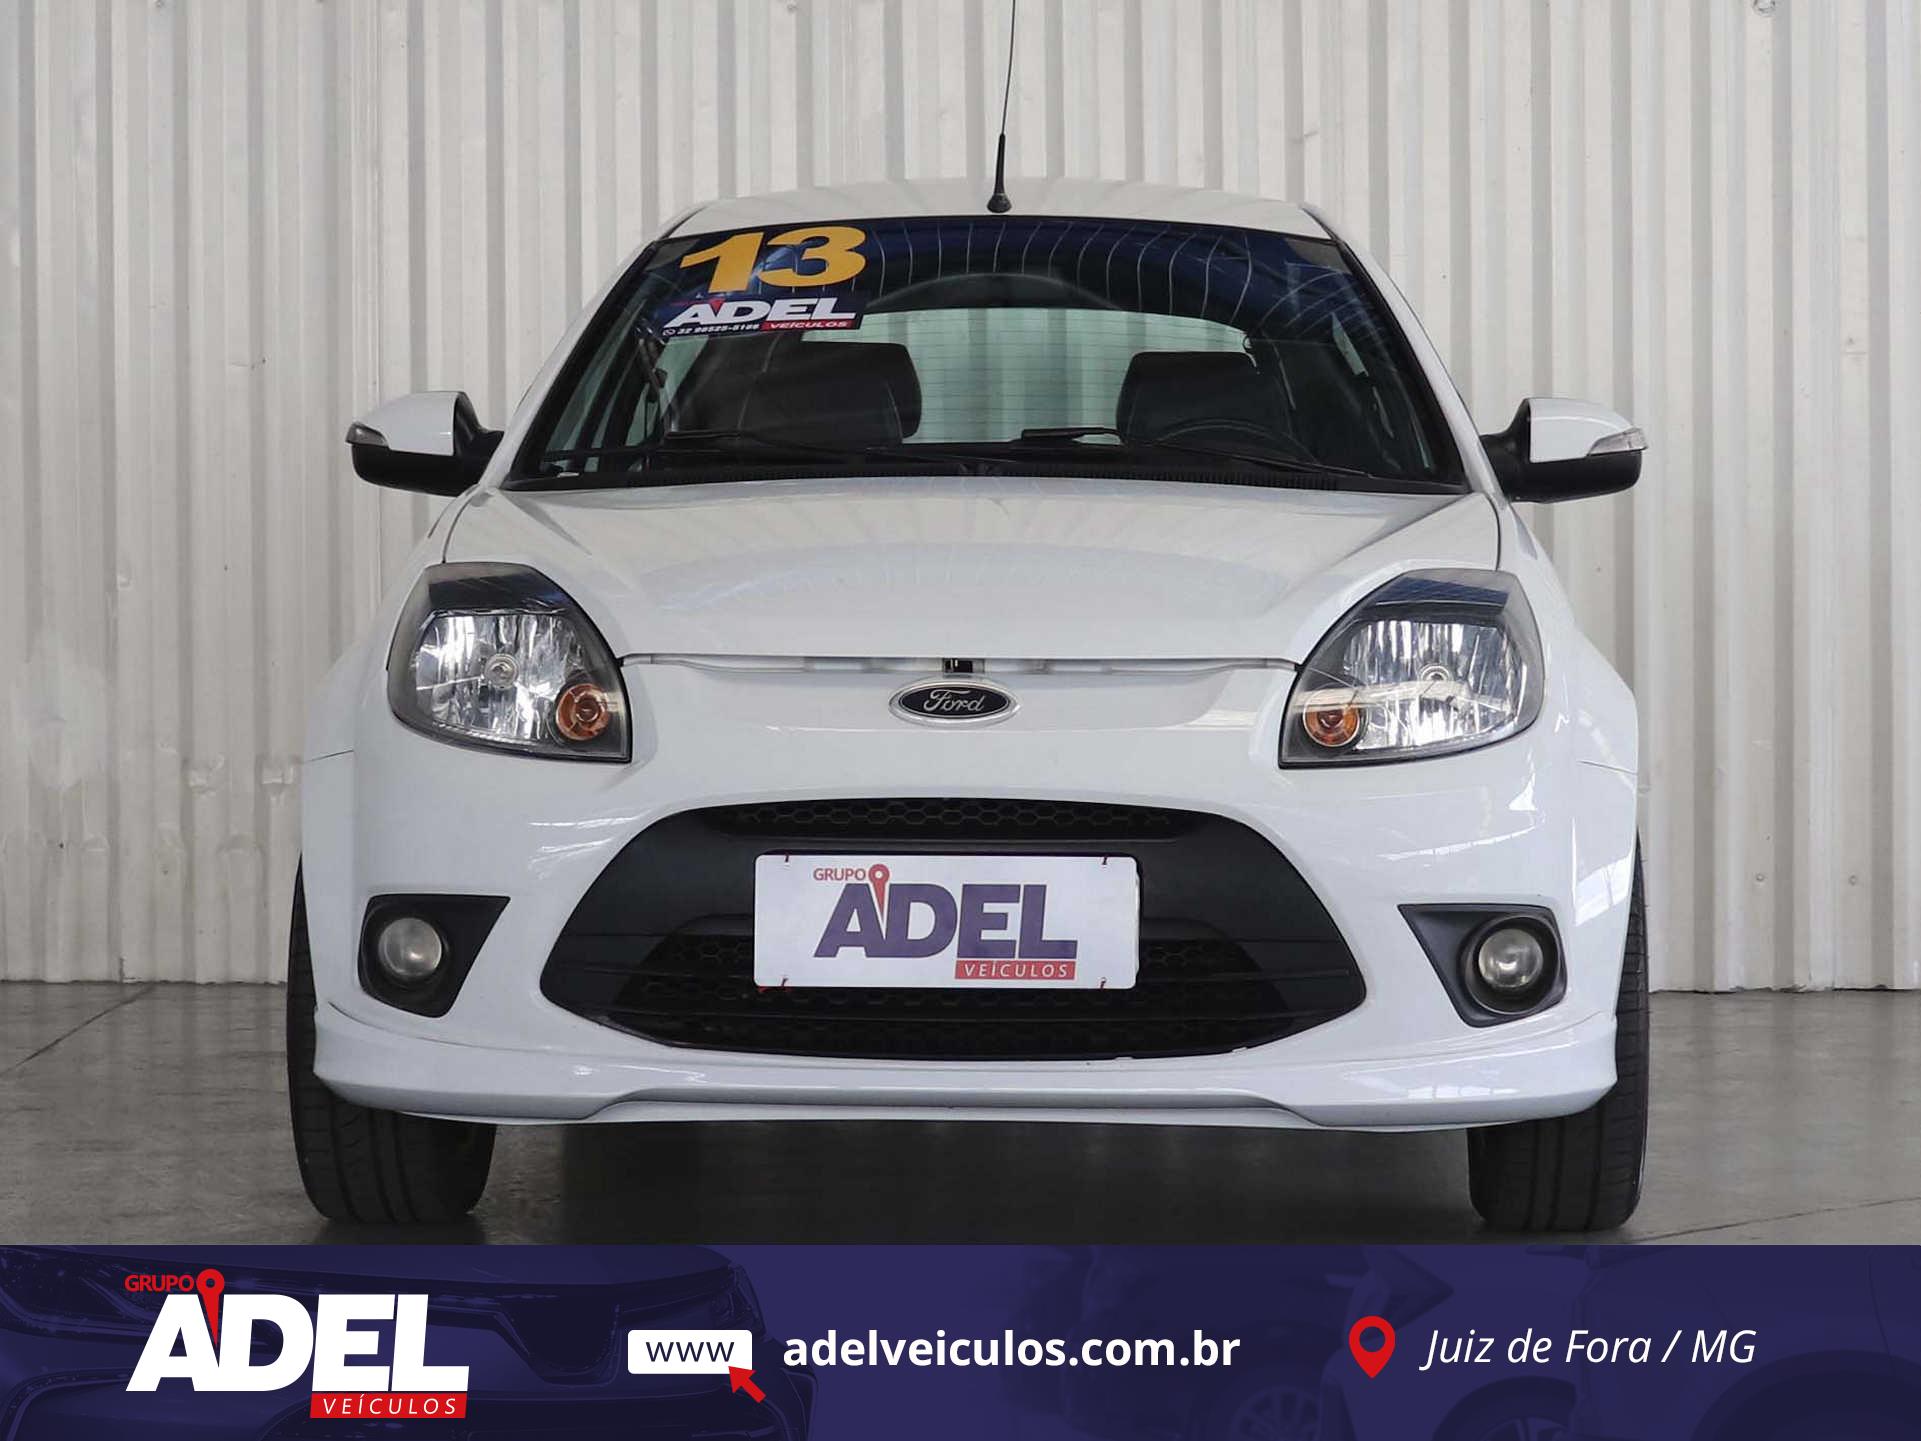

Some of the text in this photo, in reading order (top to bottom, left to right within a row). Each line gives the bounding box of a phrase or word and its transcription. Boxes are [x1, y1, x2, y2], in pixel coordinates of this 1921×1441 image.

[680, 226, 866, 294] 13
[663, 297, 856, 328] ADEL
[923, 688, 985, 712] Ford
[813, 867, 867, 881] GRUPO
[813, 882, 1078, 960] ADEL
[963, 960, 1069, 978] VEÍCULOS
